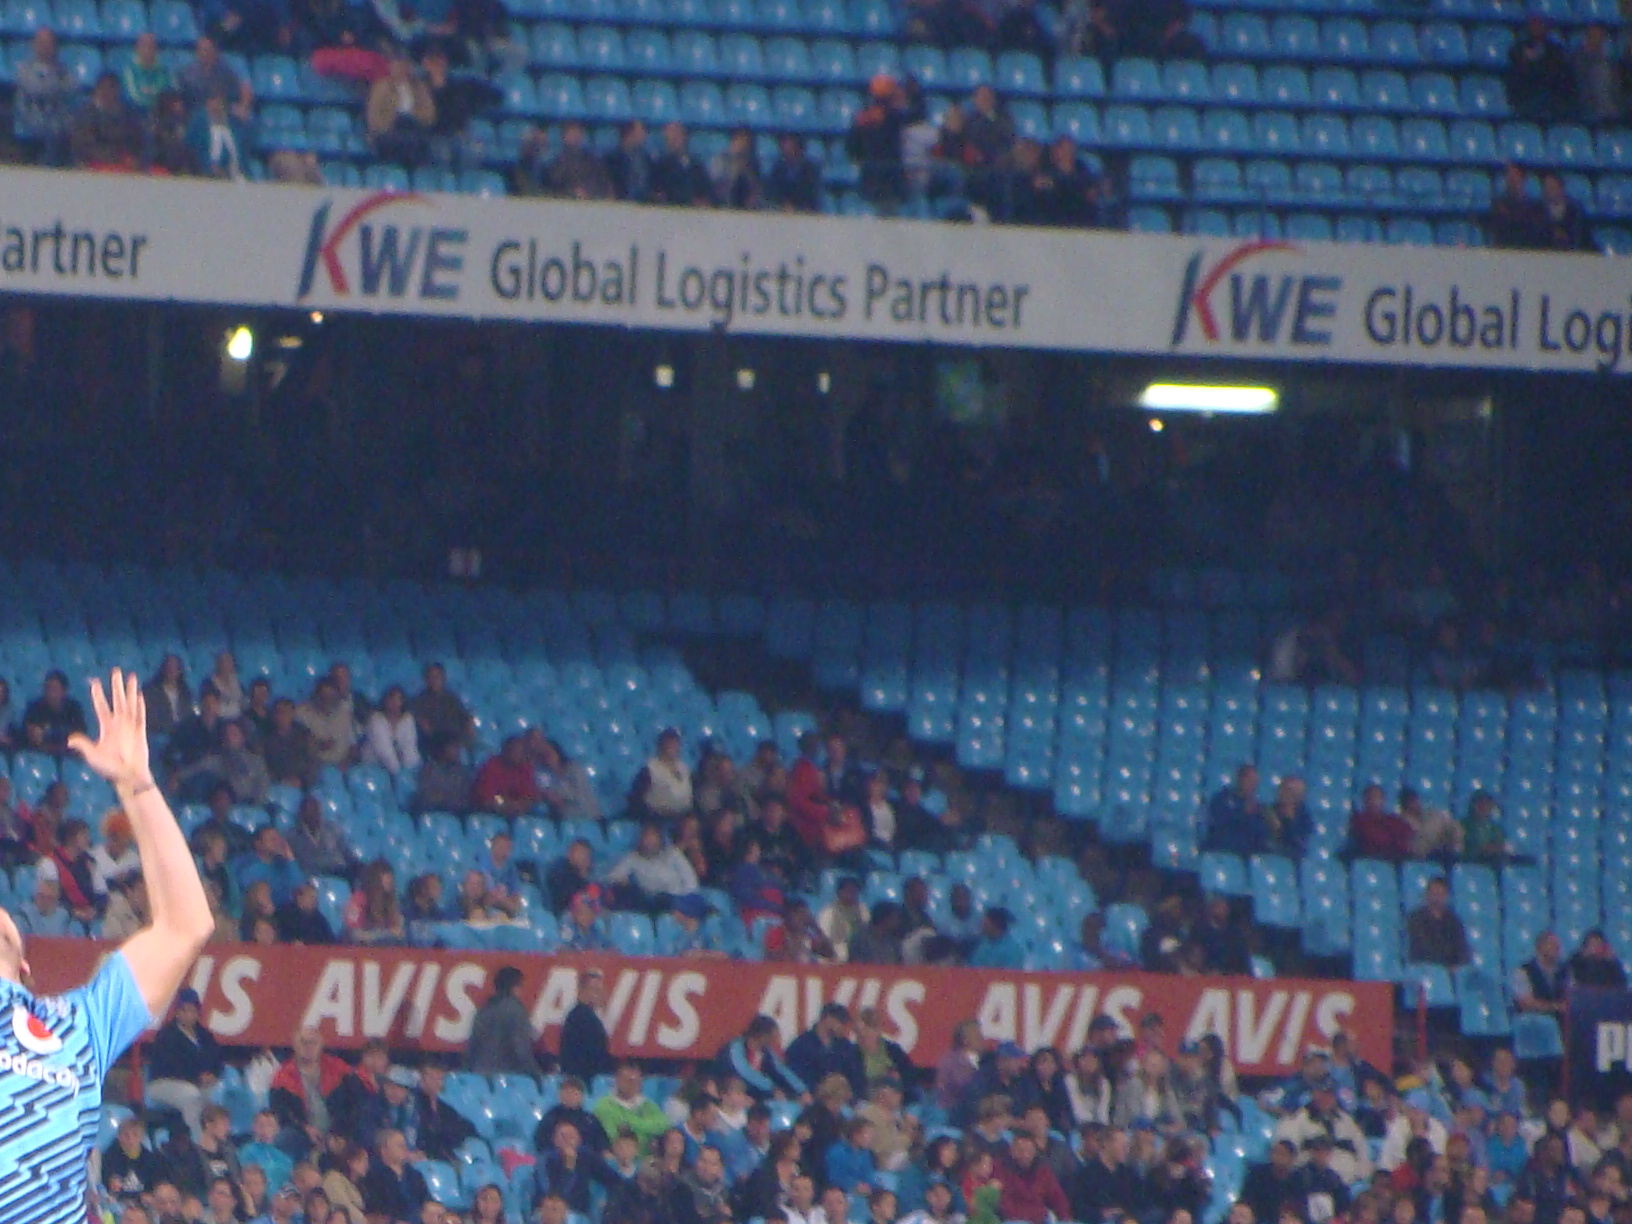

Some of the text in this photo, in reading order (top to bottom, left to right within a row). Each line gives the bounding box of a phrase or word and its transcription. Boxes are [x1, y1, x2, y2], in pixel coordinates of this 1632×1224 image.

[297, 191, 469, 301] KWE
[490, 238, 1030, 333] Global Logistics Partner
[1171, 240, 1344, 346] KWE
[1365, 283, 1521, 349] Global
[301, 959, 487, 1044] AVIS
[530, 965, 708, 1050] AVIS
[976, 980, 1144, 1055] AVIS
[1185, 986, 1357, 1066] AVIS
